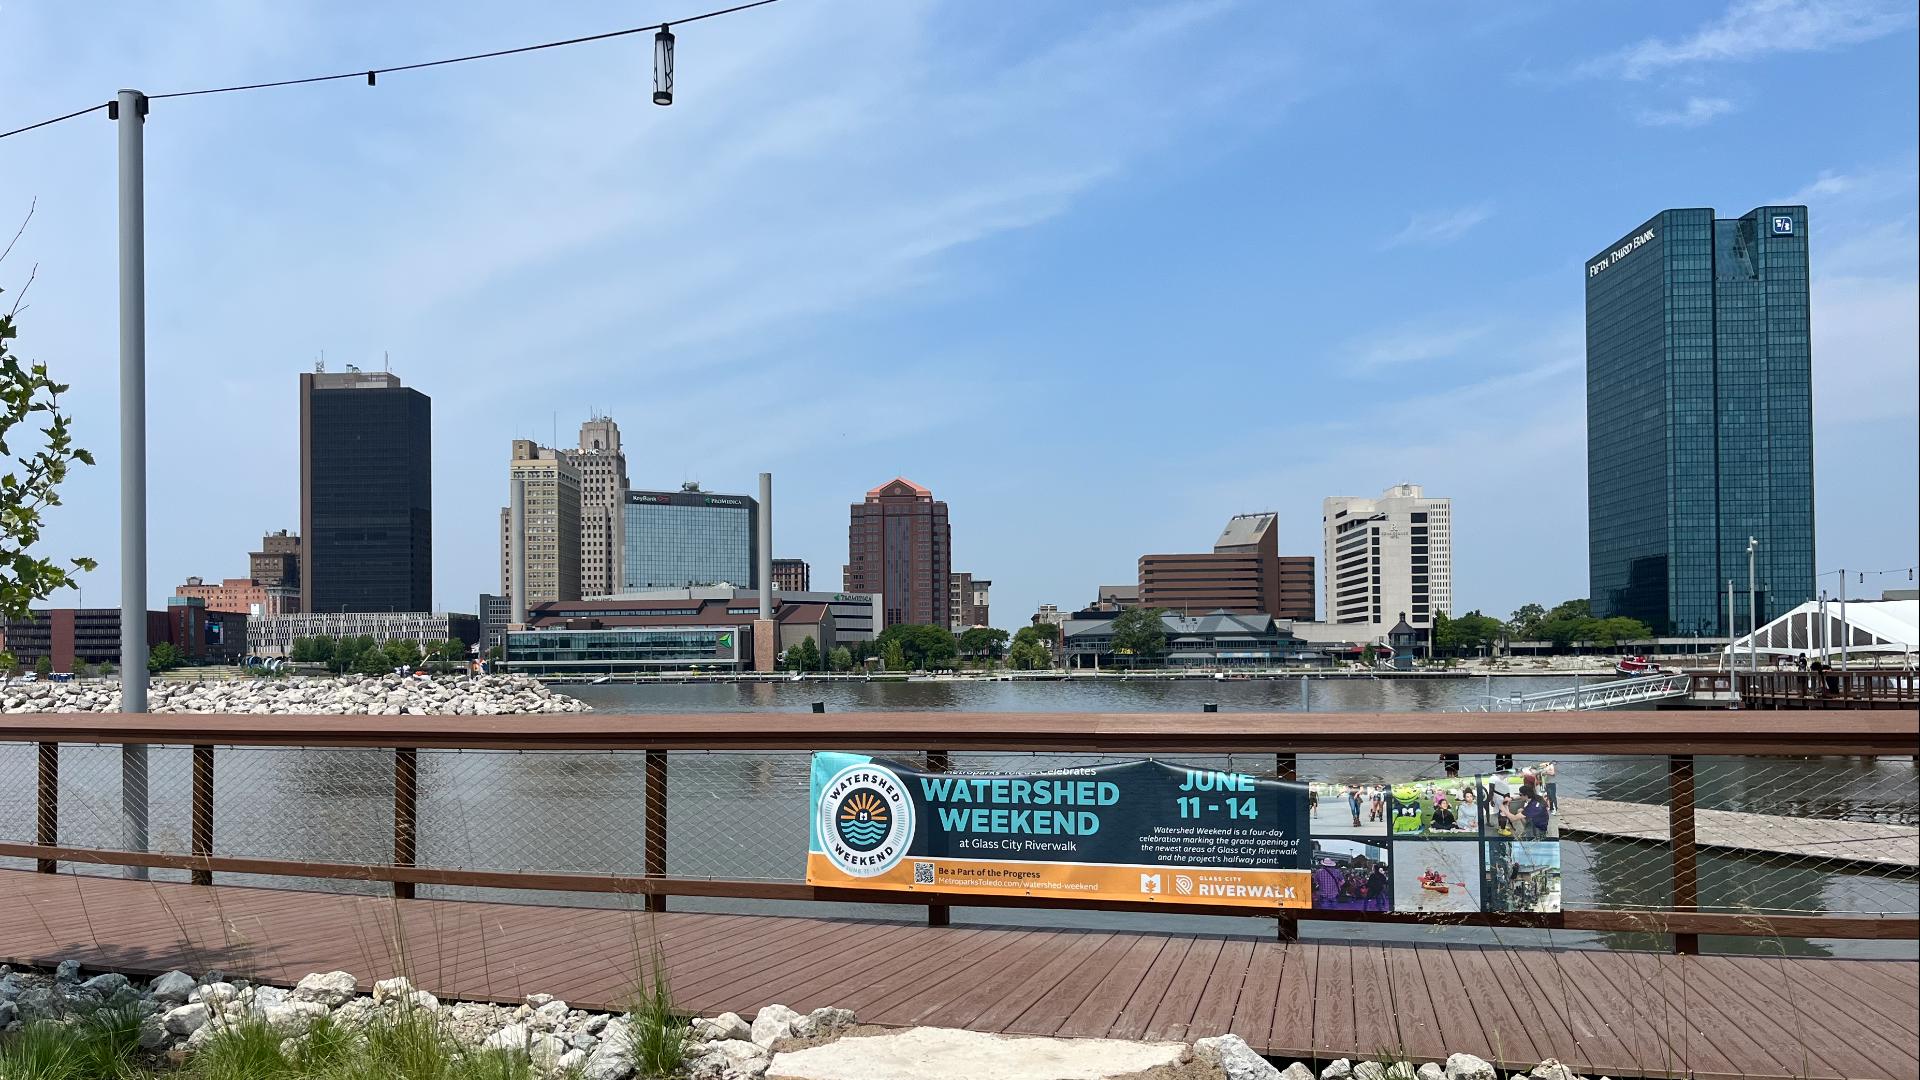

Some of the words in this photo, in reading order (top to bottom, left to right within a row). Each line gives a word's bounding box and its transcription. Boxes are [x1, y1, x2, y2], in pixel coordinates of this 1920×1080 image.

[1589, 258, 1609, 278] FIFTH
[1610, 242, 1632, 265] THIRD
[1633, 228, 1655, 249] BANK
[829, 773, 900, 802] WATERSHED
[1179, 770, 1256, 792] JUNE
[920, 778, 1120, 806] WATERSHED
[1176, 797, 1200, 819] 11
[1226, 797, 1258, 819] 14
[938, 808, 1100, 836] WEEKEND
[1154, 826, 1194, 835] Watershed
[1196, 827, 1232, 836] Weekend
[1233, 828, 1240, 836] is
[1249, 828, 1284, 838] four-day
[959, 838, 969, 848] at
[971, 838, 999, 849] Glass
[1001, 839, 1022, 852] City
[1025, 840, 1077, 852] Riverwalk
[1139, 835, 1181, 844] celebration
[1182, 836, 1214, 846] marking
[1216, 837, 1229, 845] the
[1230, 838, 1255, 847] grand
[1256, 839, 1289, 848] opening
[1290, 838, 1300, 847] of
[1141, 844, 1153, 852] the
[1154, 845, 1181, 853] newest
[1206, 845, 1216, 854] of
[1217, 846, 1239, 854] Glass
[1240, 847, 1256, 856] City
[1258, 847, 1298, 856] Riverwalk
[835, 843, 893, 866] WEEKEND
[1174, 854, 1187, 862] the
[1188, 855, 1221, 864] project's
[1222, 856, 1255, 865] halfway
[1256, 857, 1280, 865] point.
[938, 867, 949, 875] Be
[957, 868, 974, 876] Part
[976, 868, 986, 876] of
[987, 869, 1002, 877] the
[1003, 870, 1040, 879] Progress
[1199, 884, 1295, 898] RIVERWALK
